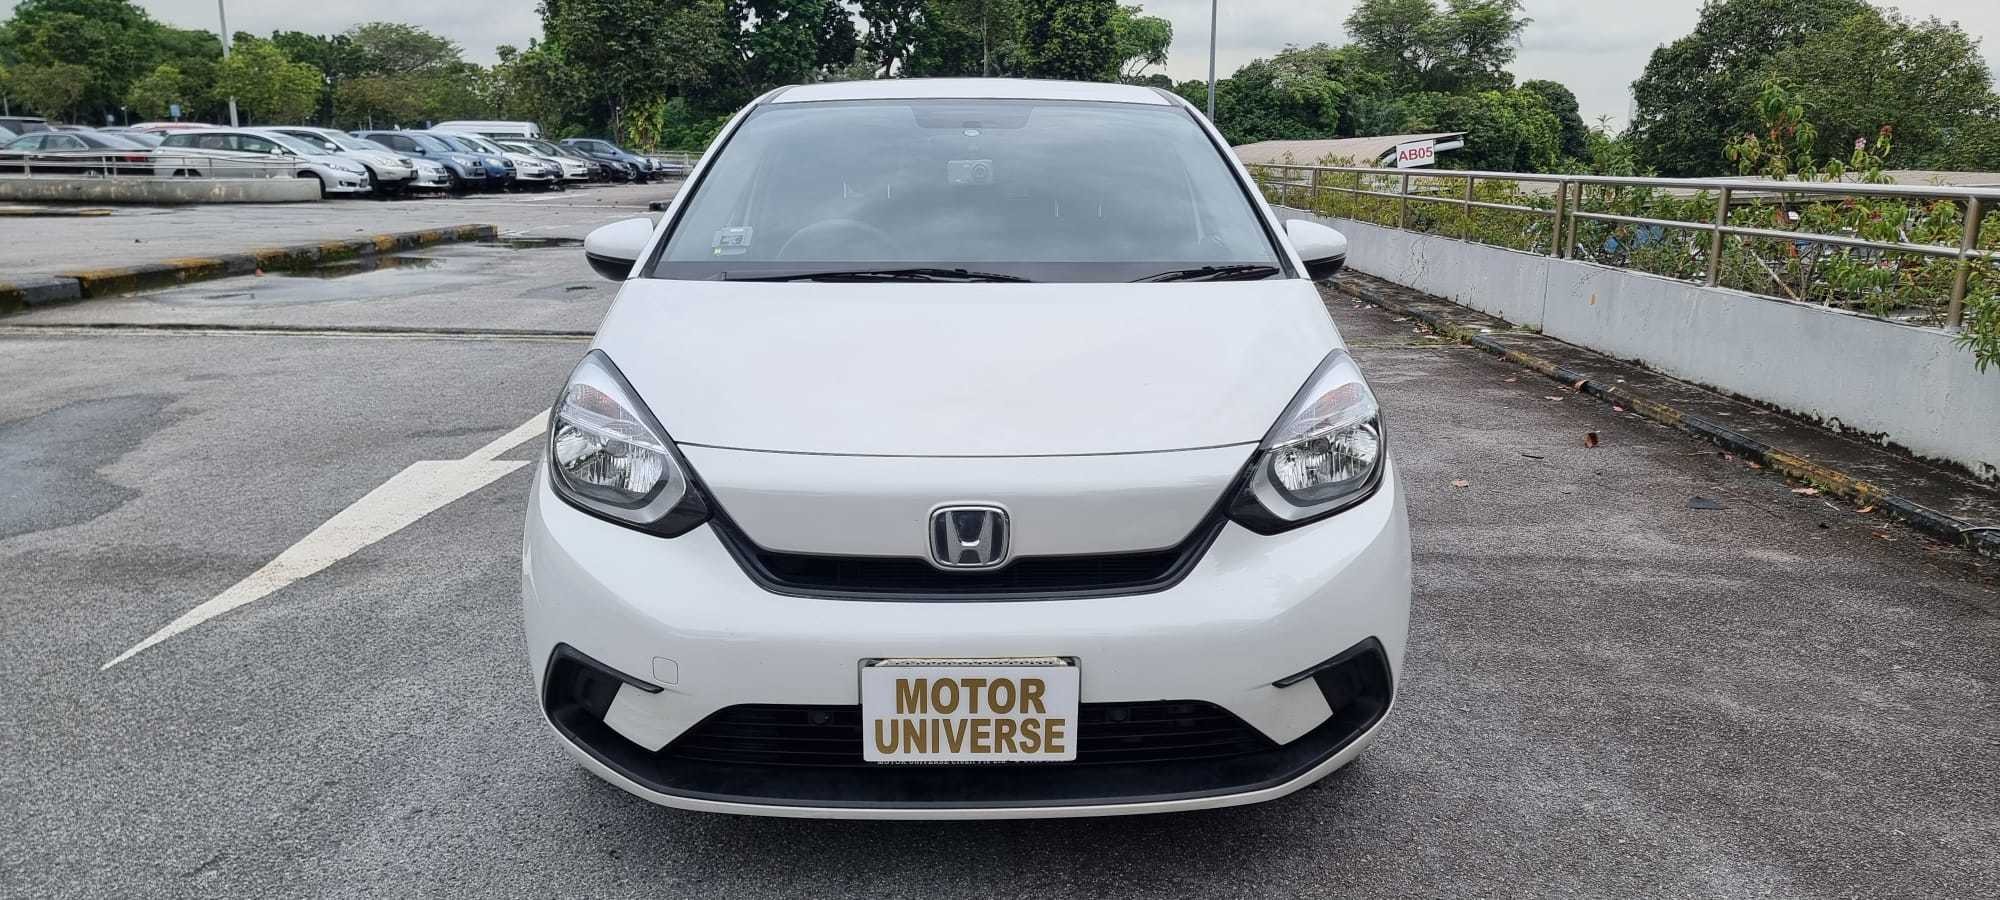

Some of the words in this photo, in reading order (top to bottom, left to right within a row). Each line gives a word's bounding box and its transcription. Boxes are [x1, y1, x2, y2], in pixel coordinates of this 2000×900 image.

[1399, 146, 1433, 162] AB05
[895, 677, 1047, 715] MOTOR
[874, 717, 1066, 755] UNIVERSE
